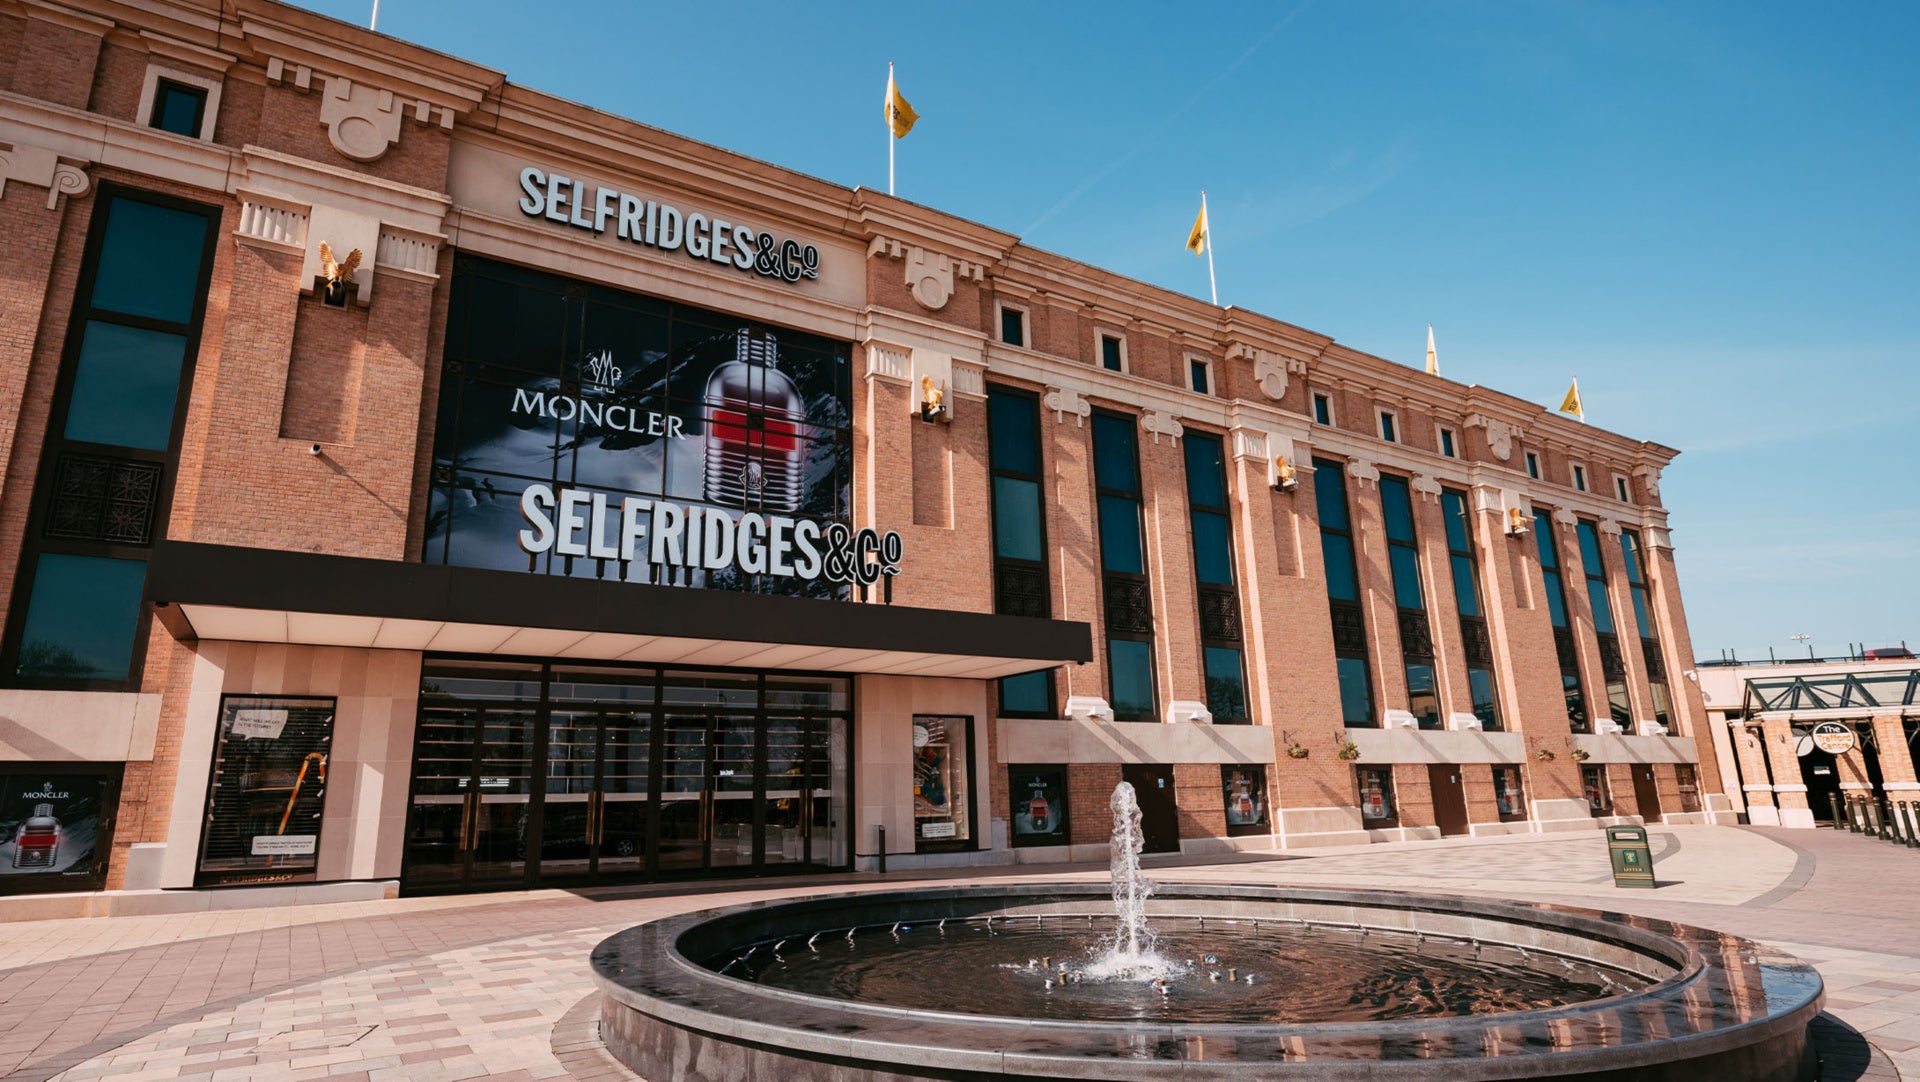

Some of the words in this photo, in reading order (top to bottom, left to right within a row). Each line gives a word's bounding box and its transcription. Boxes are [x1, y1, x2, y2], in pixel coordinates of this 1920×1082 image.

[511, 388, 686, 440] MONCLER
[1823, 725, 1841, 733] The
[22, 791, 70, 799] MONCLER
